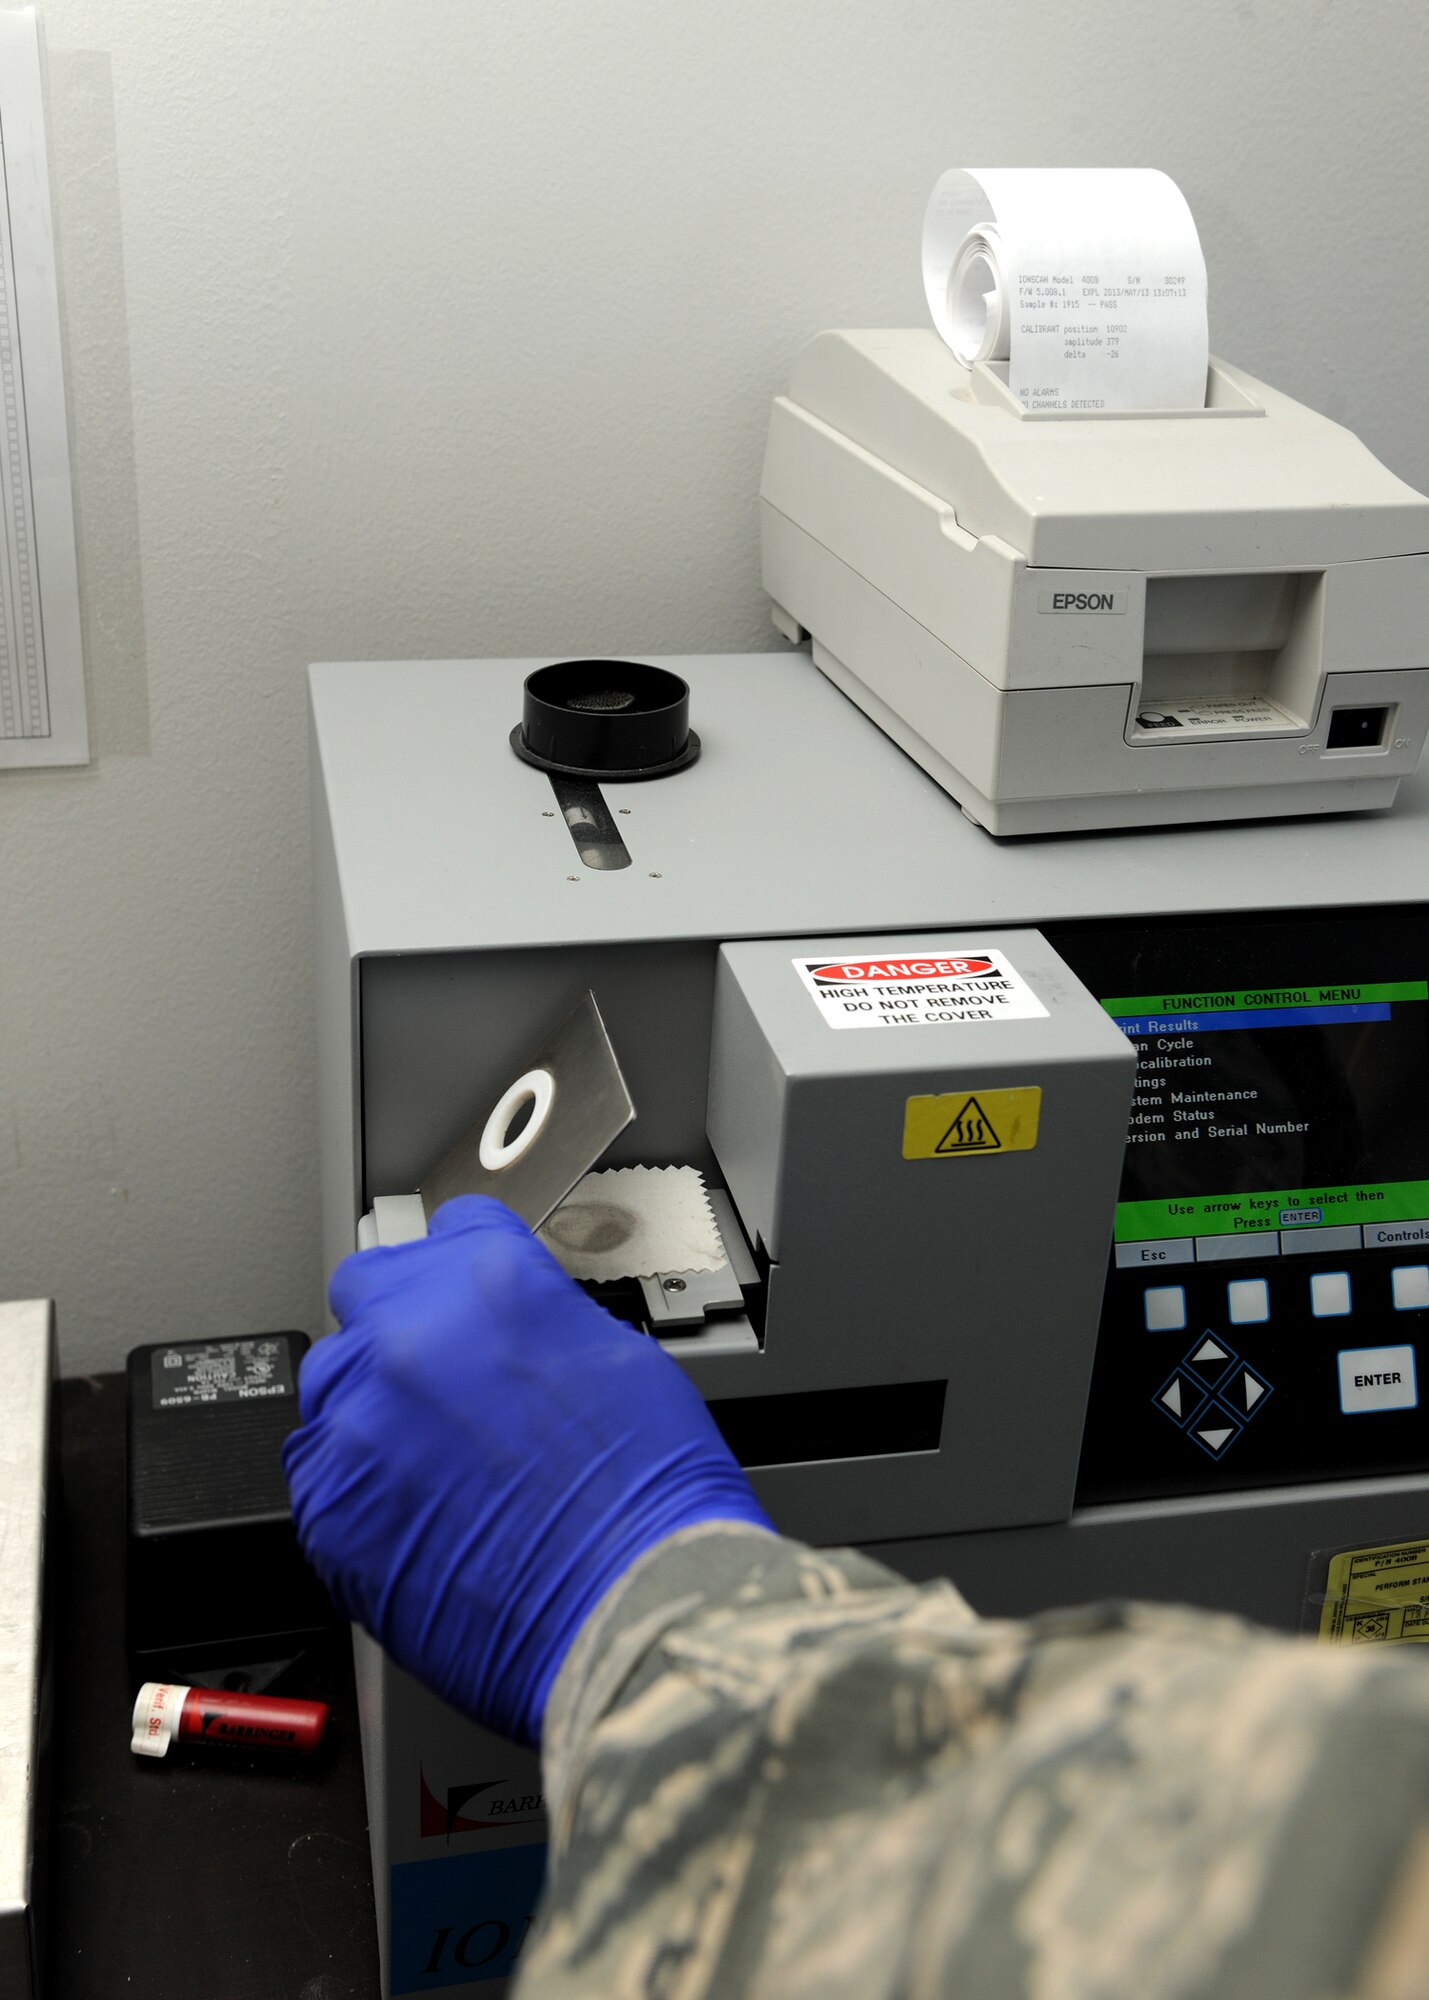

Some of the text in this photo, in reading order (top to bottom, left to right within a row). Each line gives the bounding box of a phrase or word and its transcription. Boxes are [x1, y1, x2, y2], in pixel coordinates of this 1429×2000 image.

[1018, 275, 1049, 284] IONSCAN
[1052, 275, 1074, 284] Model
[1127, 276, 1141, 285] S/N
[1019, 288, 1032, 296] F/W
[1082, 288, 1100, 297] EXPL
[1103, 288, 1150, 297] 2013/MAY/13
[1019, 300, 1046, 310] Sample
[1062, 300, 1080, 309] 1915
[1099, 300, 1118, 309] PASS
[1021, 325, 1128, 335] CALIBRANT position 10902
[1063, 337, 1120, 347] amplitude 379
[1063, 350, 1119, 359] delta -26
[1019, 388, 1059, 397] NO ALARMS
[1032, 400, 1068, 409] CHANNELS
[1070, 400, 1105, 409] DETECTED
[1052, 593, 1114, 610] EPSON
[1189, 718, 1228, 726] ERROR
[1233, 715, 1273, 723] POWER
[1299, 744, 1320, 756] OFF
[1394, 738, 1411, 750] ON
[841, 960, 972, 979] DANGER
[819, 980, 1015, 999] HIGH TEMPERATURE
[842, 994, 1010, 1012] DO NOT REMOVE
[1162, 988, 1361, 1011] FUNCTION CONTROL MENU
[878, 1009, 993, 1025] THE COVER
[1148, 1019, 1199, 1033] Results
[1157, 1038, 1194, 1052] Cycle
[1136, 1055, 1212, 1070] calibration
[1134, 1076, 1167, 1089] tings
[1131, 1088, 1258, 1107] stem Maintenance
[1128, 1108, 1215, 1125] odem Status
[1125, 1120, 1310, 1144] ersion and Serial Number
[1167, 1189, 1385, 1216] Use arrow keys to select then
[1233, 1210, 1320, 1229] Press ENTER
[1377, 1228, 1429, 1243] Controls
[1141, 1248, 1167, 1262] Esc
[1354, 1372, 1402, 1388] ENTER
[238, 1384, 286, 1398] EPSON
[1375, 1580, 1410, 1591] PERFORM
